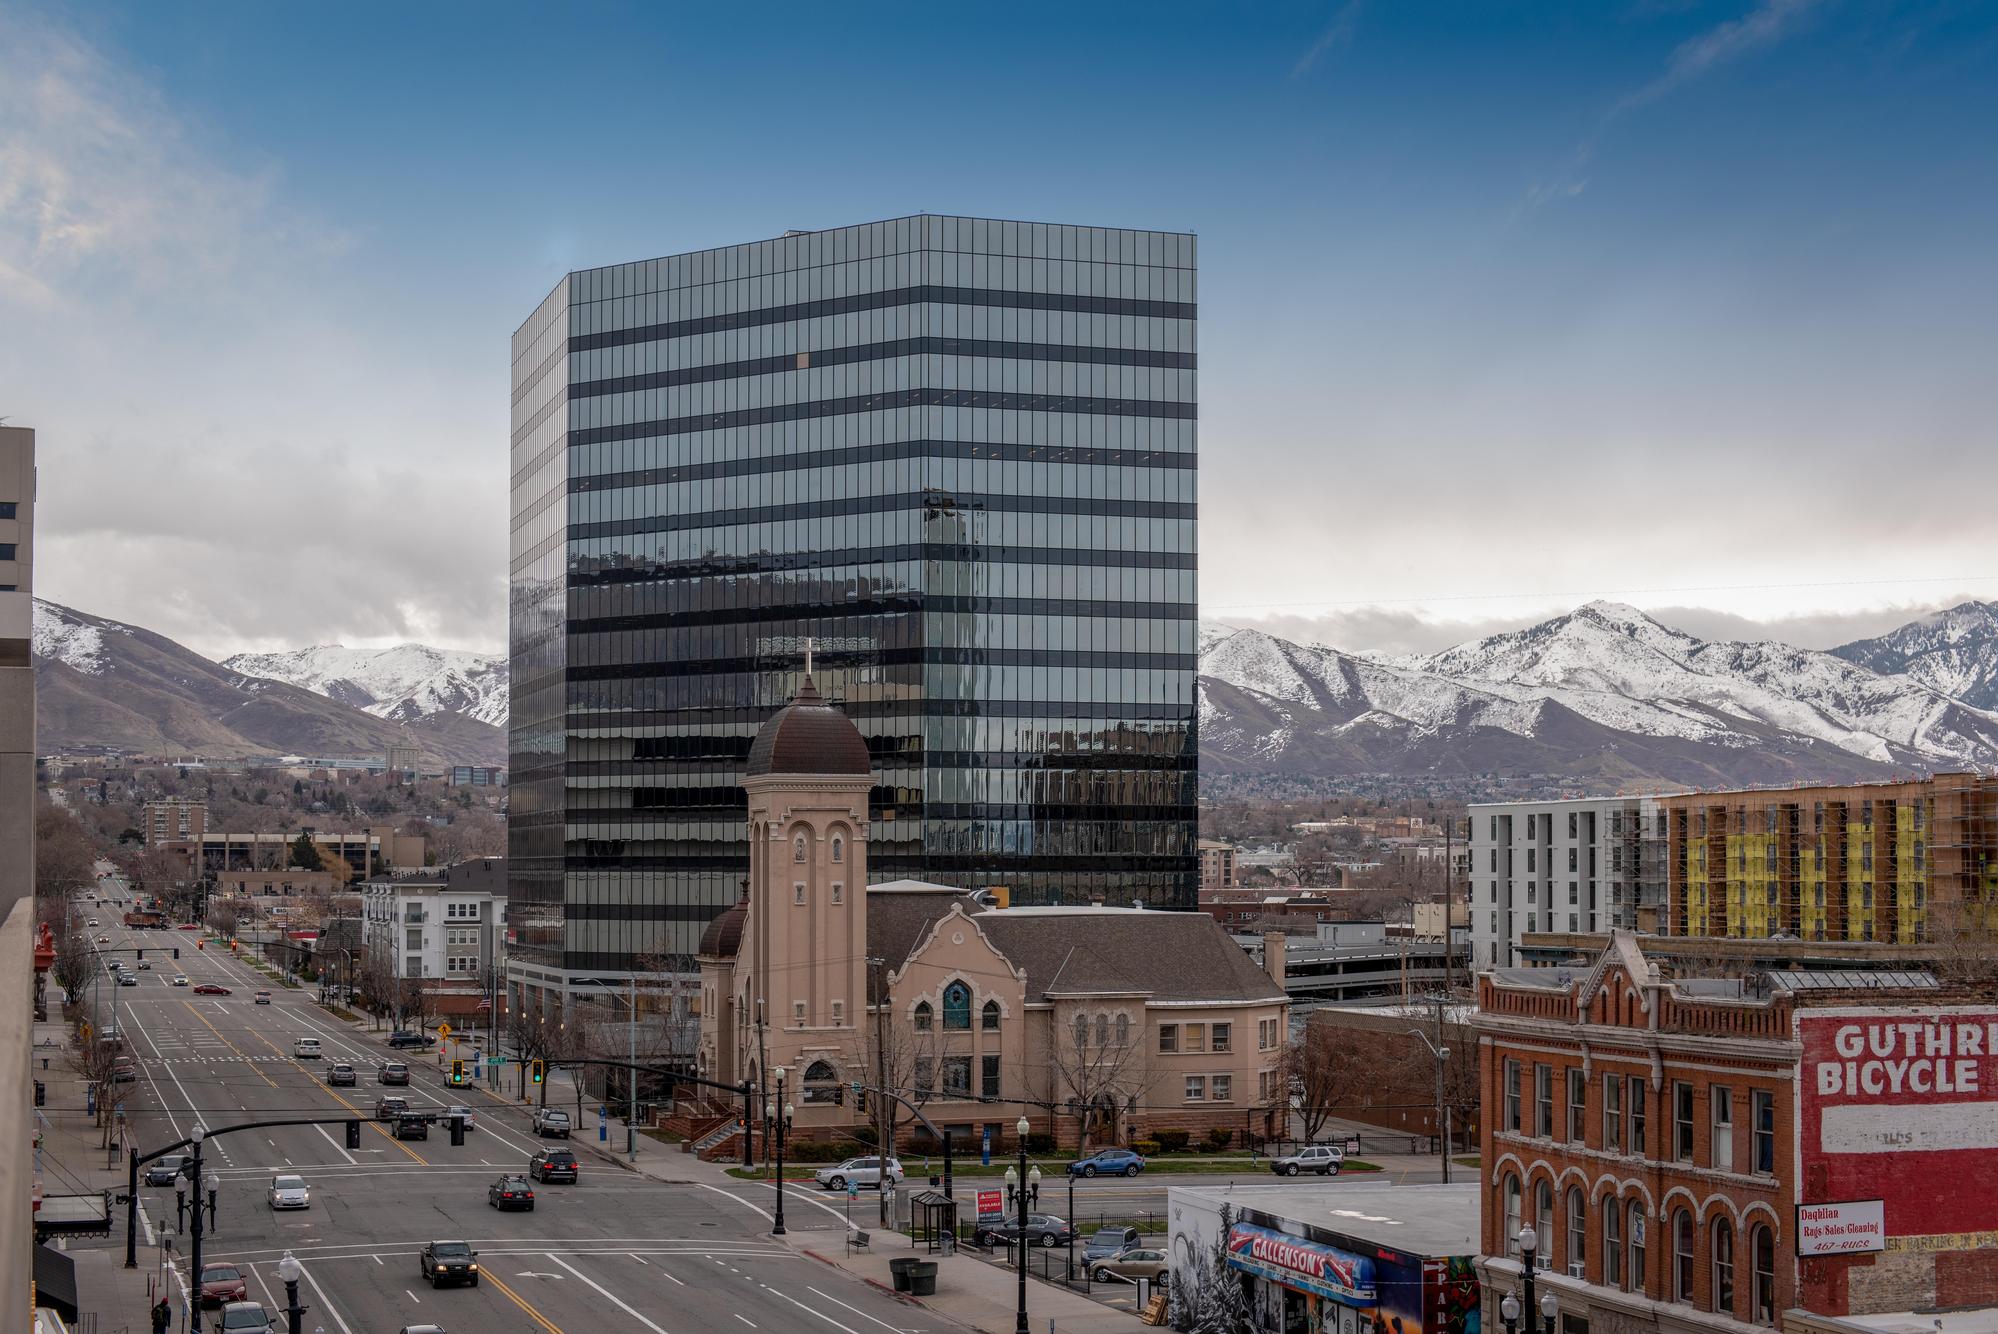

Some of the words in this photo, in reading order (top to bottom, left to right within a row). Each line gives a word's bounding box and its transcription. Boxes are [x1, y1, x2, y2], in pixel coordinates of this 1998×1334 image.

[1817, 1059, 1979, 1095] BICYCLE
[1252, 1238, 1326, 1277] GALLENSON'S
[1814, 1239, 1871, 1252] 467-RUGS
[1317, 1279, 1334, 1290] CLOTHING
[1341, 1287, 1354, 1296] OPTICS
